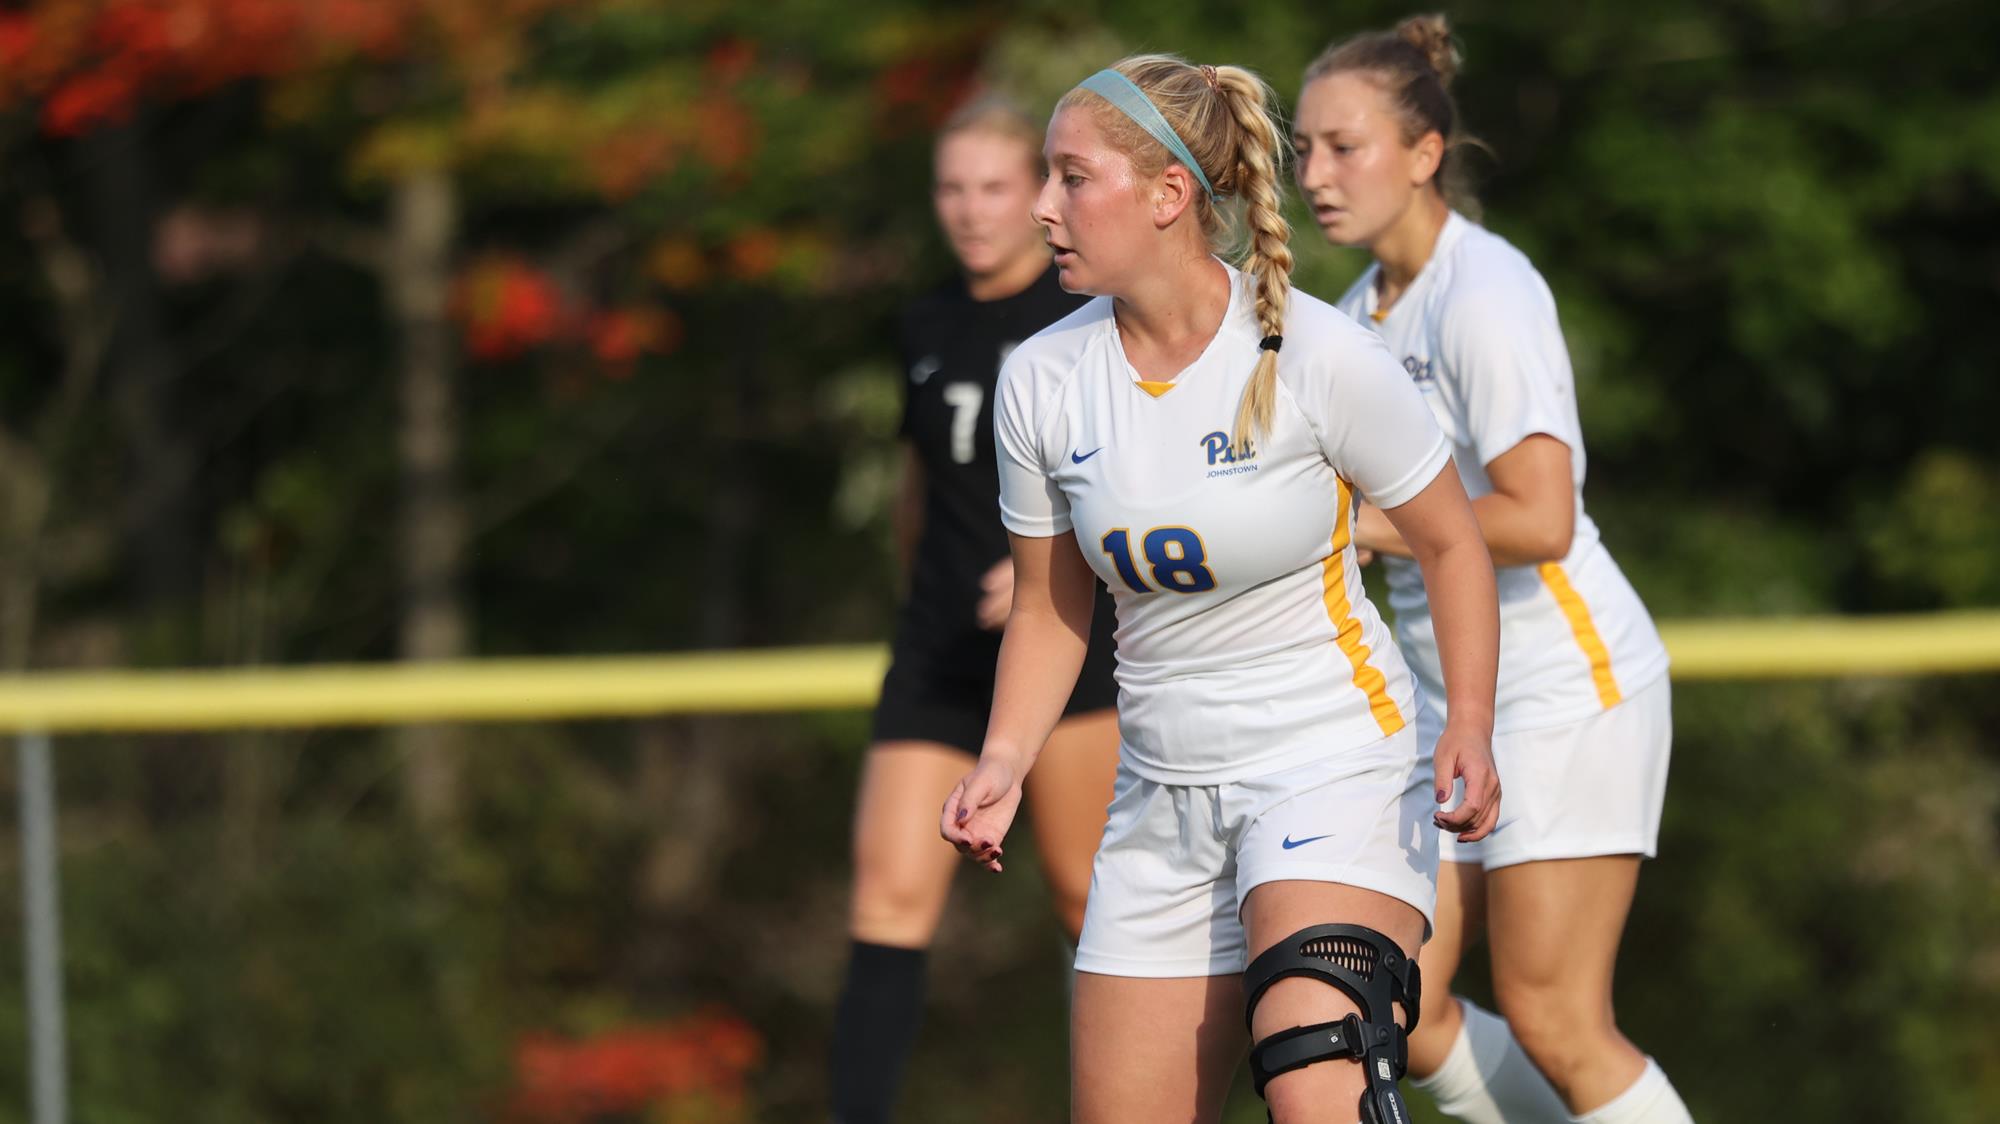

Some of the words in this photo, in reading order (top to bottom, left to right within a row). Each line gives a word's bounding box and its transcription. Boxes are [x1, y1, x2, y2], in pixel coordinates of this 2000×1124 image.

[943, 382, 984, 464] 7
[1200, 431, 1256, 465] Pi
[1206, 464, 1258, 478] JOHNSTOWN
[1100, 525, 1218, 594] 18
